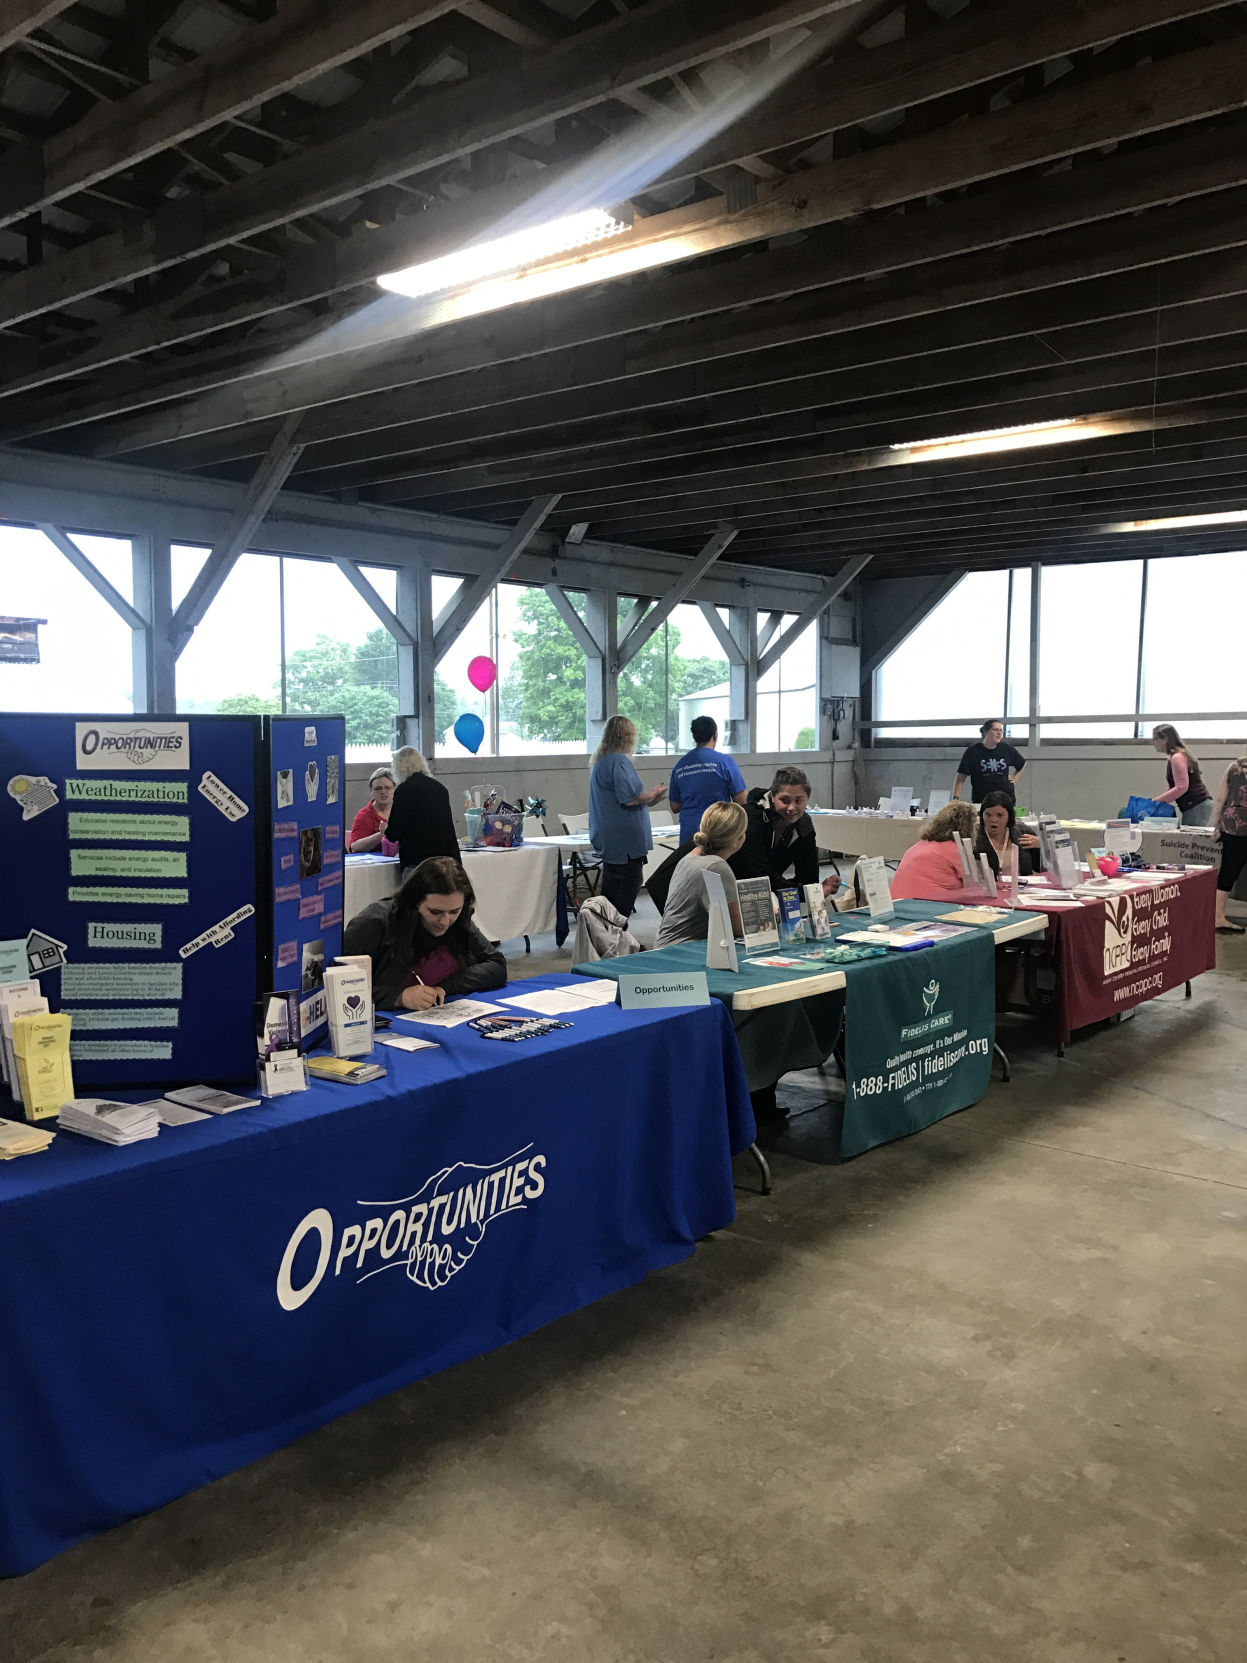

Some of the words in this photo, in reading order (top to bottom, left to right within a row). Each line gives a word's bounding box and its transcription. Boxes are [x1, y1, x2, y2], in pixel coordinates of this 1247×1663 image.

[69, 782, 185, 801] Weatherization
[206, 774, 227, 796] Lower
[227, 794, 246, 813] Home
[1160, 839, 1190, 849] Suicide
[1179, 850, 1216, 863] Coalition
[1133, 891, 1152, 911] Every
[92, 926, 157, 944] Housing
[182, 941, 200, 954] Help
[201, 930, 217, 942] with
[218, 907, 253, 930] Affording
[1132, 916, 1152, 937] Every
[213, 932, 232, 946] Rent
[1132, 943, 1150, 963] Every
[1151, 931, 1172, 955] Family
[634, 982, 694, 995] Opportunities
[1113, 971, 1163, 1002] www.ncppc.org
[901, 1023, 929, 1038] FIDELIS
[944, 1036, 952, 1046] Our
[852, 1062, 917, 1100] 1-888-FIDELIS
[924, 1037, 988, 1076] fideliscare.org
